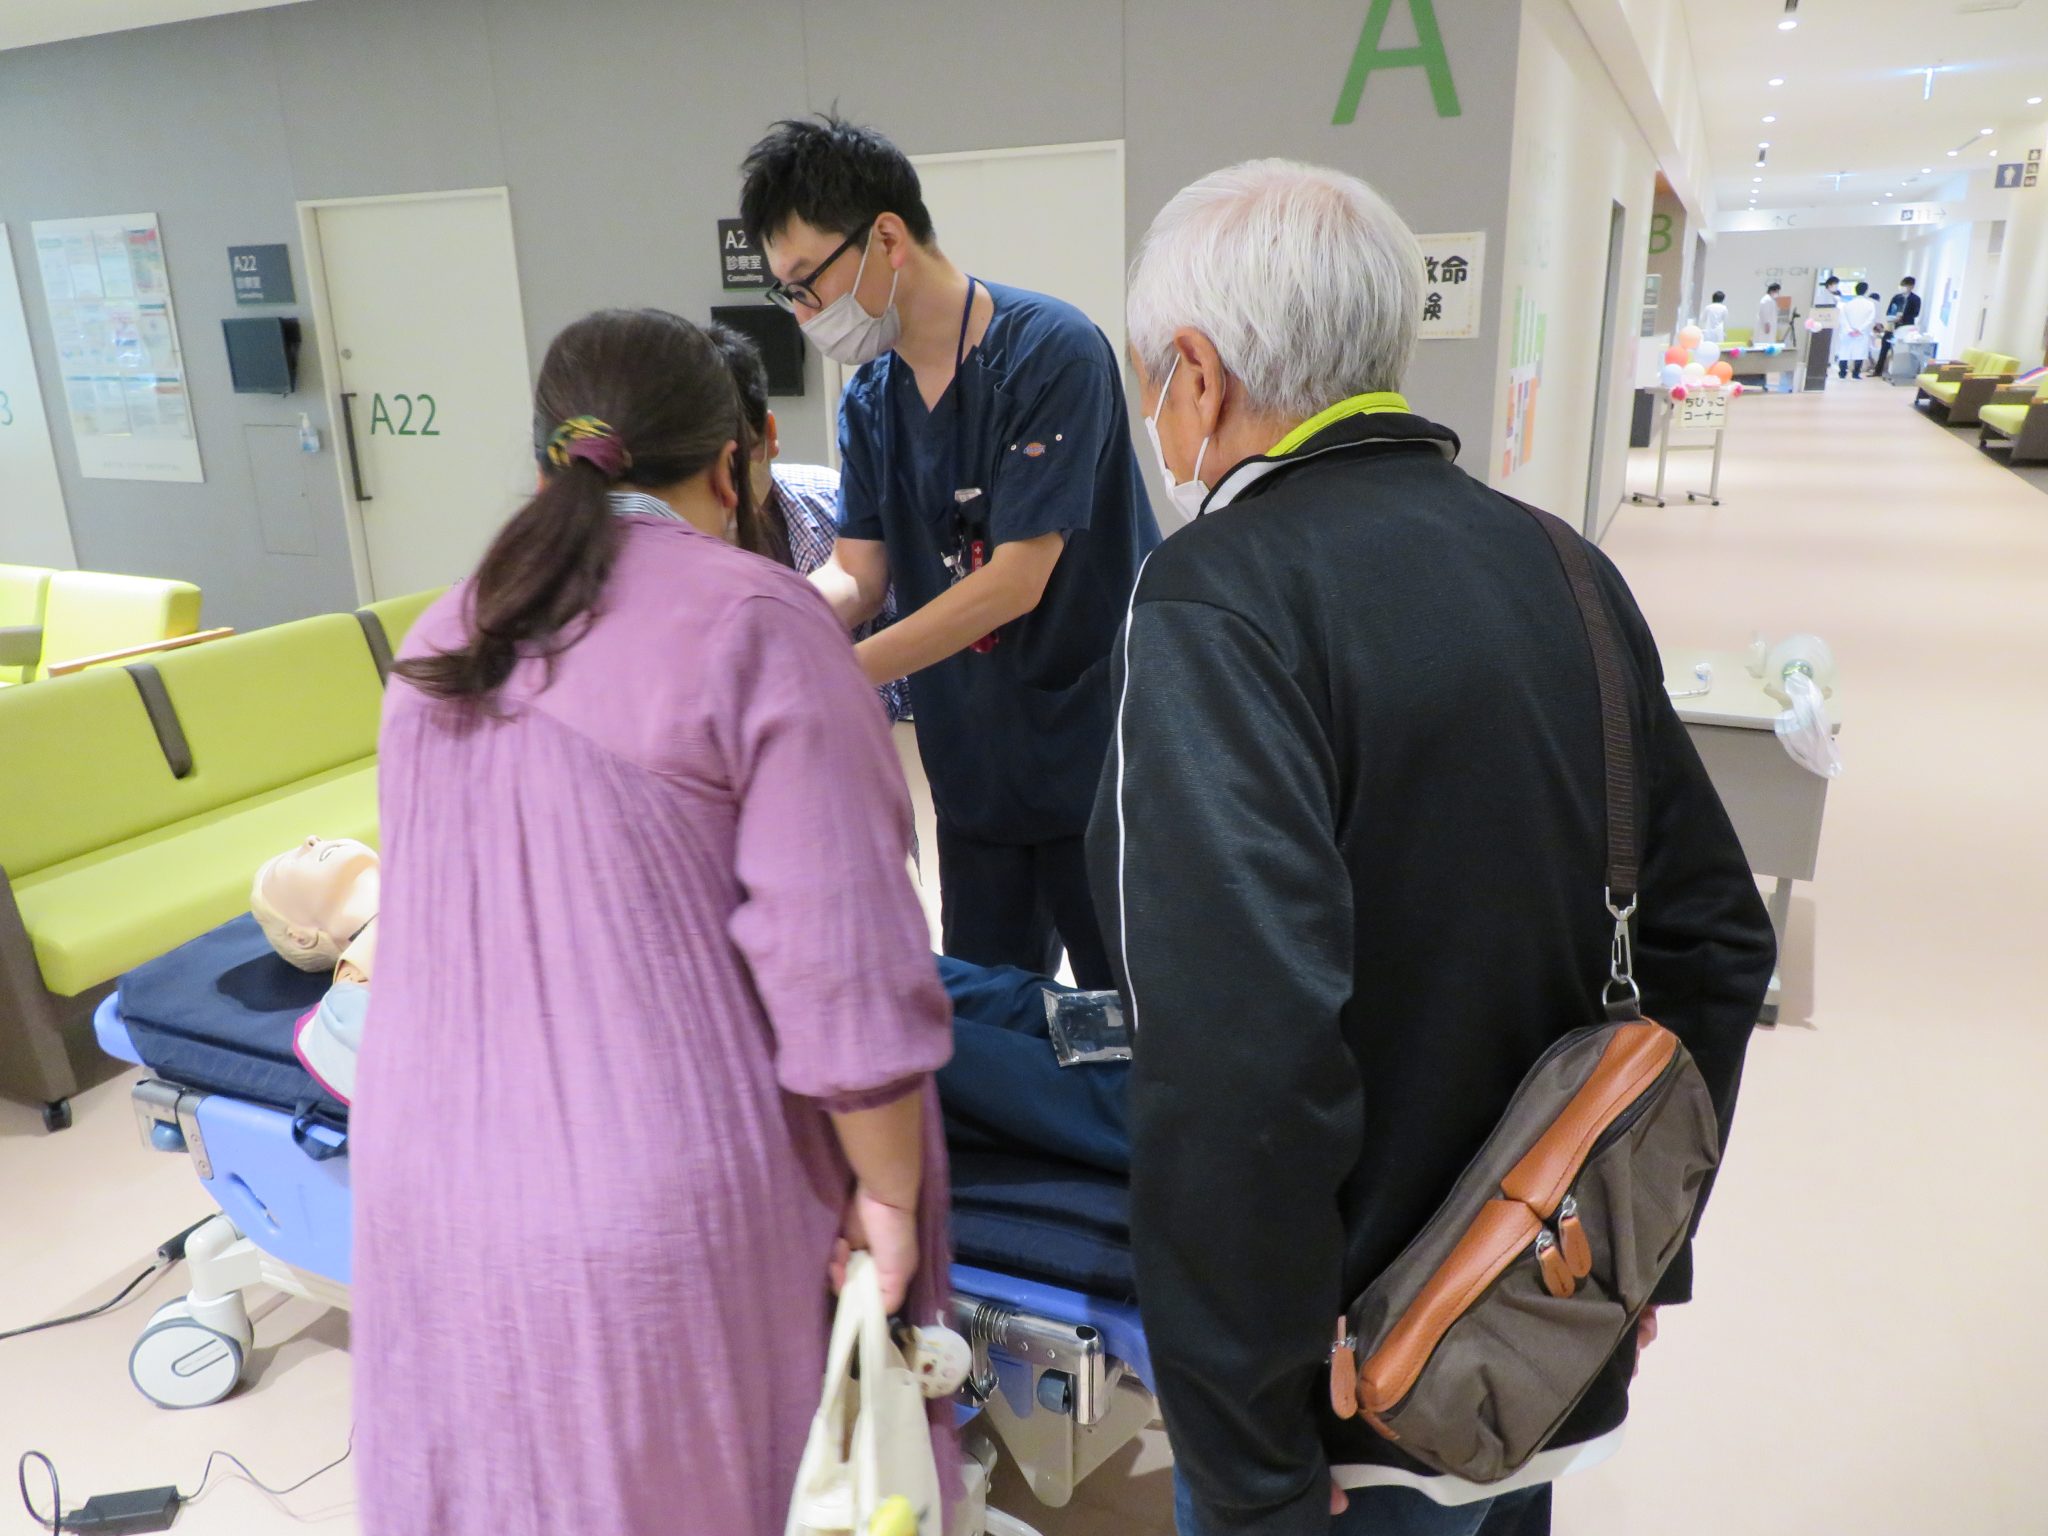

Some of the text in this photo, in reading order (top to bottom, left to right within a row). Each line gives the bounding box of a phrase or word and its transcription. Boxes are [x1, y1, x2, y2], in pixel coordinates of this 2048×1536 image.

[1332, 0, 1462, 125] A
[725, 230, 749, 250] A2
[1648, 213, 1673, 255] B
[233, 254, 258, 272] A22
[726, 255, 763, 271] 診察室
[1685, 396, 1725, 408] ちびっこ
[370, 392, 441, 436] A22
[1684, 411, 1724, 420] コーナー
